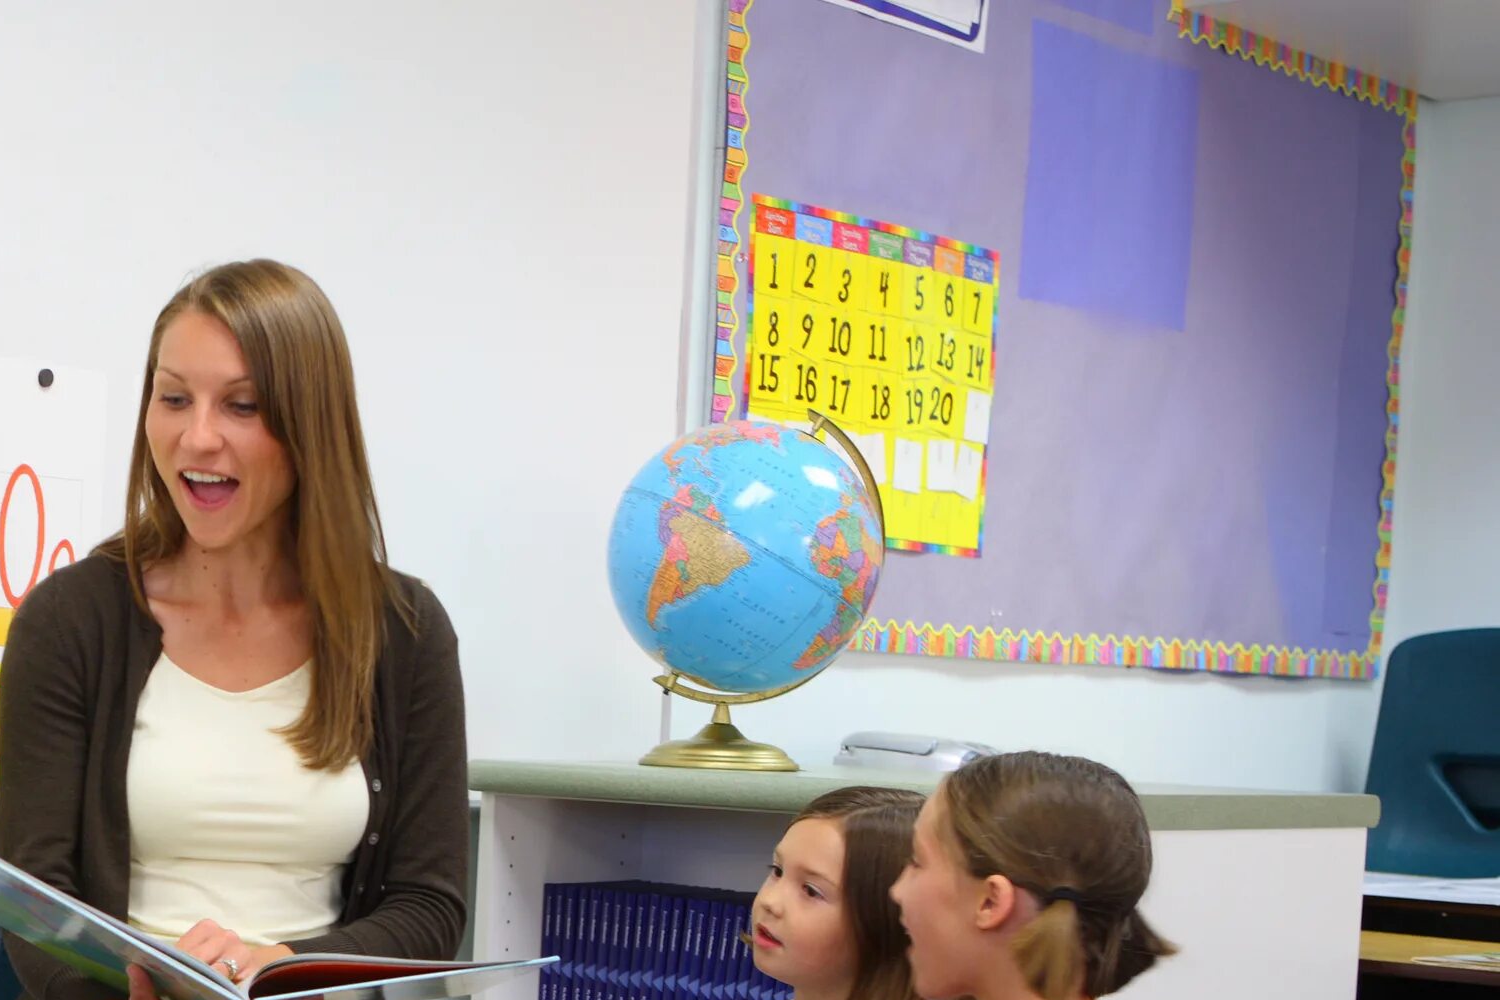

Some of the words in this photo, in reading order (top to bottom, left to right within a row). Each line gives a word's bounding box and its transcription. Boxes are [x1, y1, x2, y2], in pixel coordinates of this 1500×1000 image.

[769, 253, 778, 289] 1
[804, 254, 816, 288] 2
[838, 269, 851, 302] 3
[880, 271, 889, 308] 4
[915, 275, 924, 310] 5
[945, 282, 954, 317] 6
[973, 291, 981, 324] 7
[768, 312, 779, 346] 8
[802, 314, 813, 349] 9
[829, 317, 851, 356] 10
[869, 324, 886, 361] 11
[906, 336, 924, 371] 12
[937, 333, 956, 371] 13
[967, 344, 985, 381] 14
[758, 353, 780, 392] 15
[795, 364, 817, 402] 16
[829, 375, 851, 414] 17
[871, 384, 890, 420] 18
[906, 389, 923, 424] 19
[929, 387, 953, 425] 20
